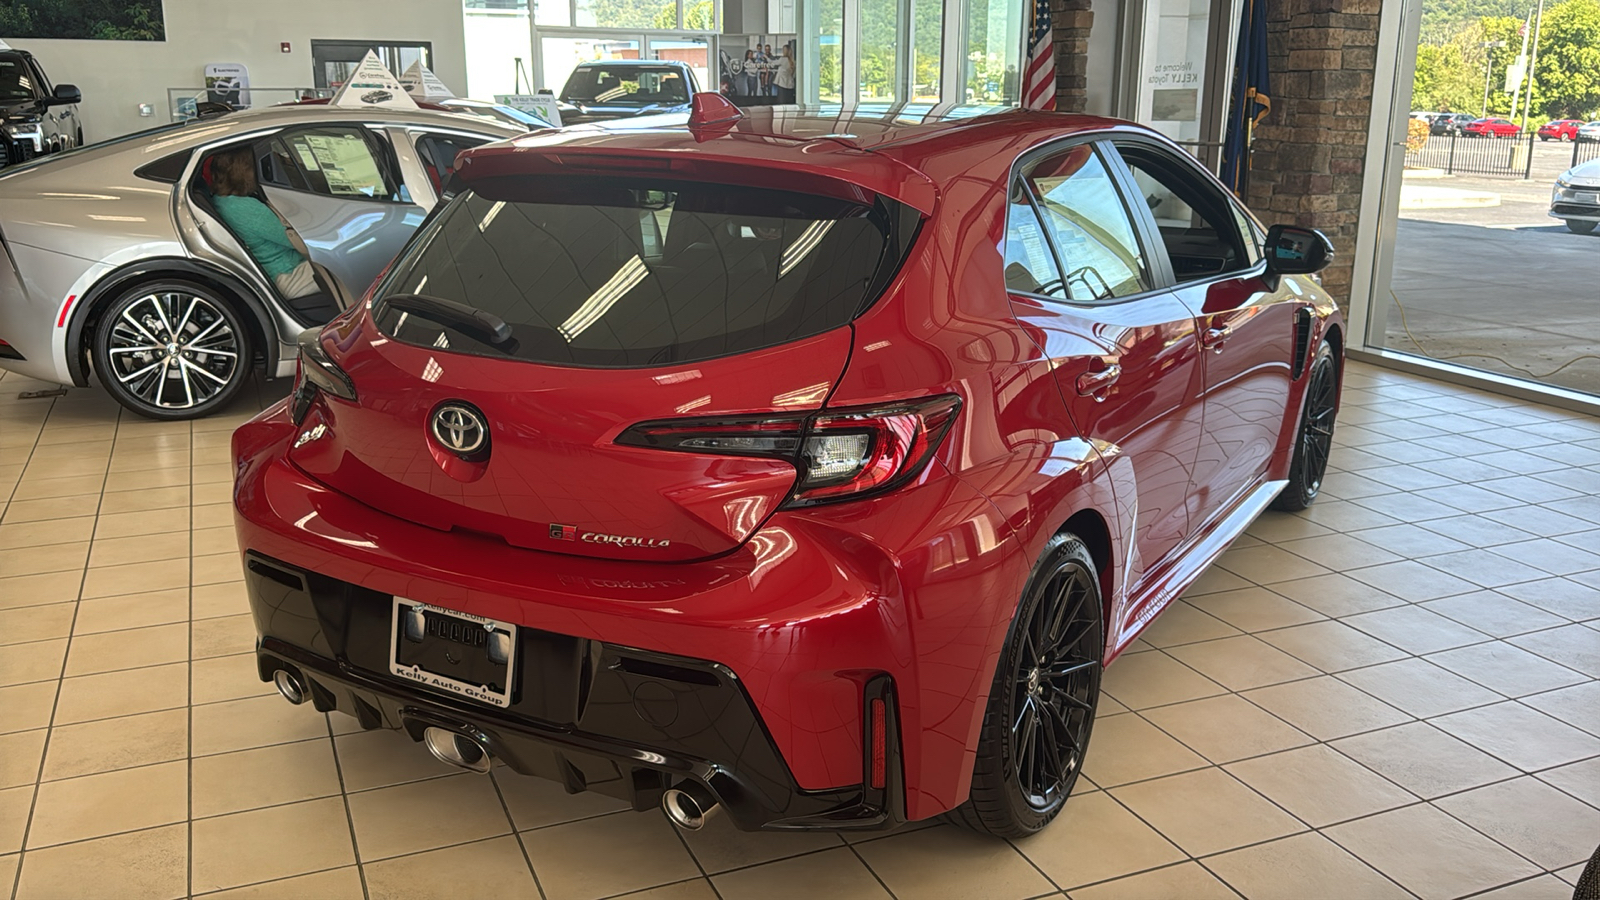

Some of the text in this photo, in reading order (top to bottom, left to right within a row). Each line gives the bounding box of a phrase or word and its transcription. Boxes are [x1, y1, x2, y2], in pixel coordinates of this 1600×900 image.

[581, 532, 670, 548] COROLLA
[396, 668, 503, 705] Kelly Auto Group
[1002, 676, 1012, 759] MICHELIN
